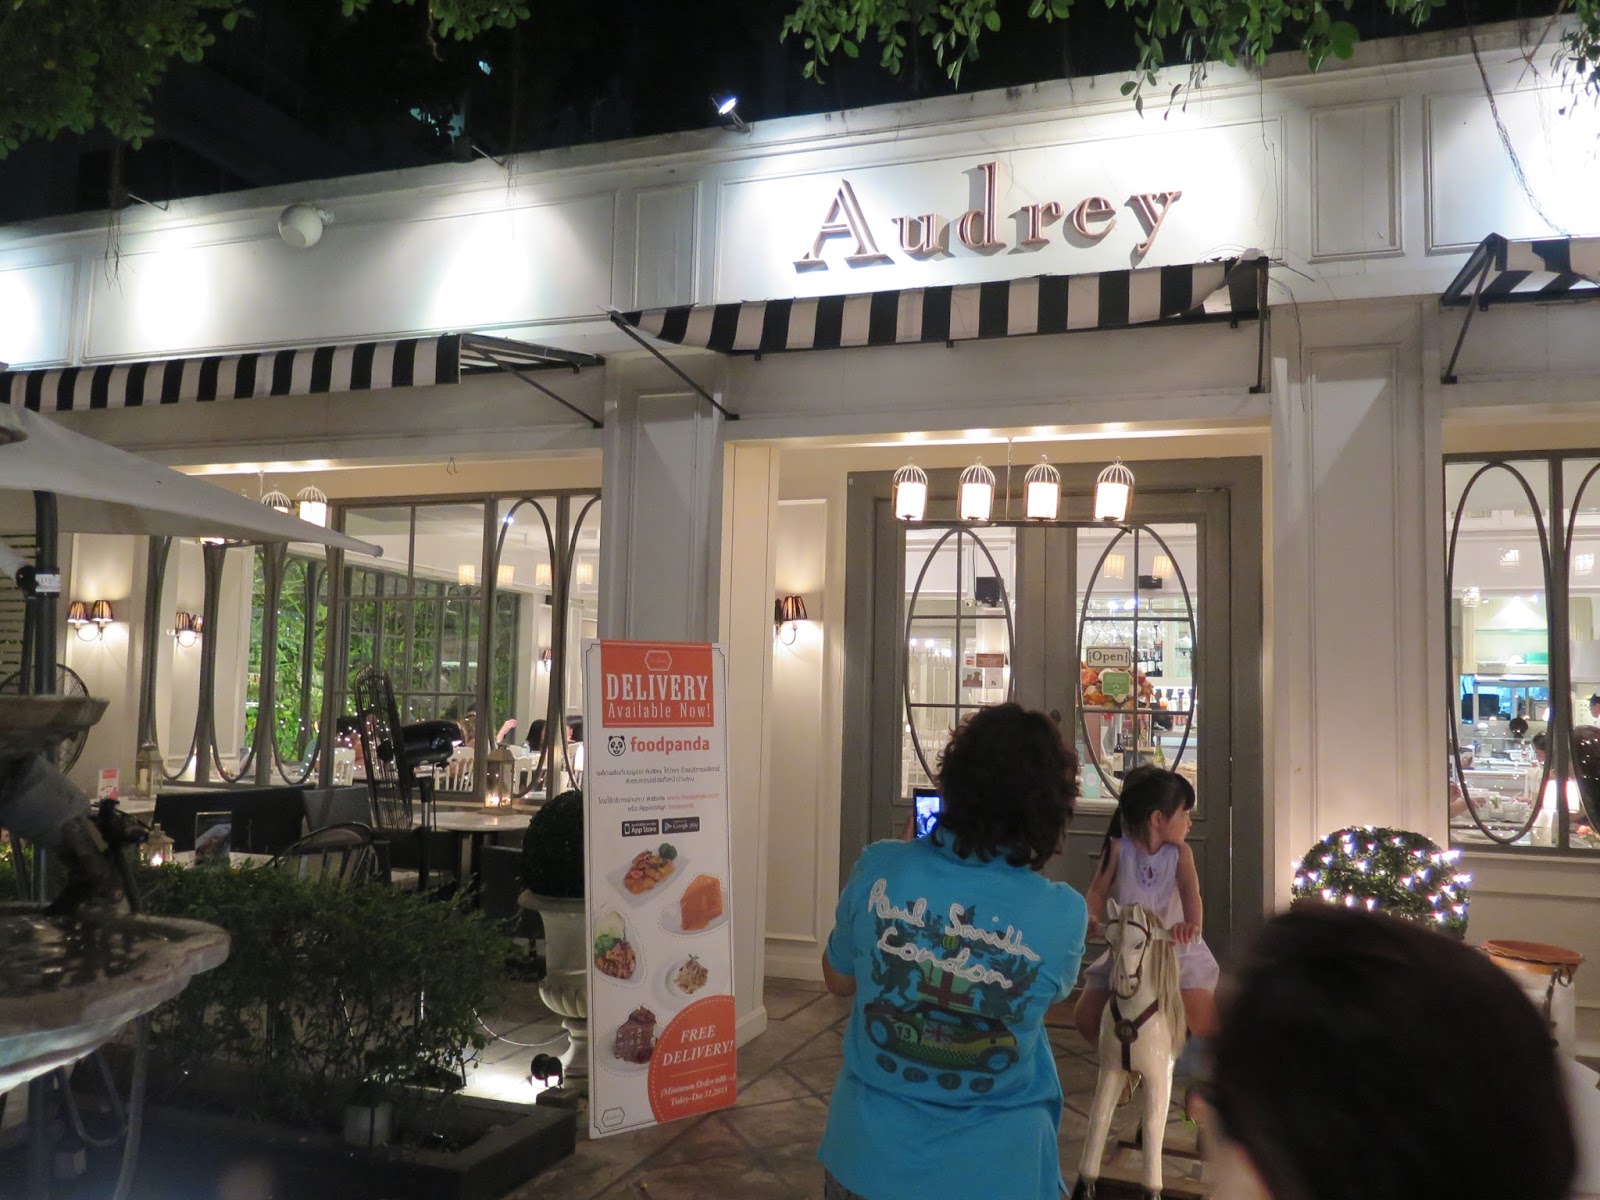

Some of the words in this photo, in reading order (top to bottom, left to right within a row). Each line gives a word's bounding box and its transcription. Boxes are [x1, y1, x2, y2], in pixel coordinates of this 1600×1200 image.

[793, 161, 1183, 264] Audrey
[1092, 651, 1124, 664] Open
[606, 673, 708, 701] DELIVERY
[608, 702, 671, 718] Available
[680, 702, 710, 718] Now!
[630, 735, 710, 756] foodpanda
[868, 879, 927, 927] Paul
[945, 903, 1040, 961] Smith
[680, 1024, 717, 1043] FREE
[662, 1039, 735, 1067] DELIVERY!
